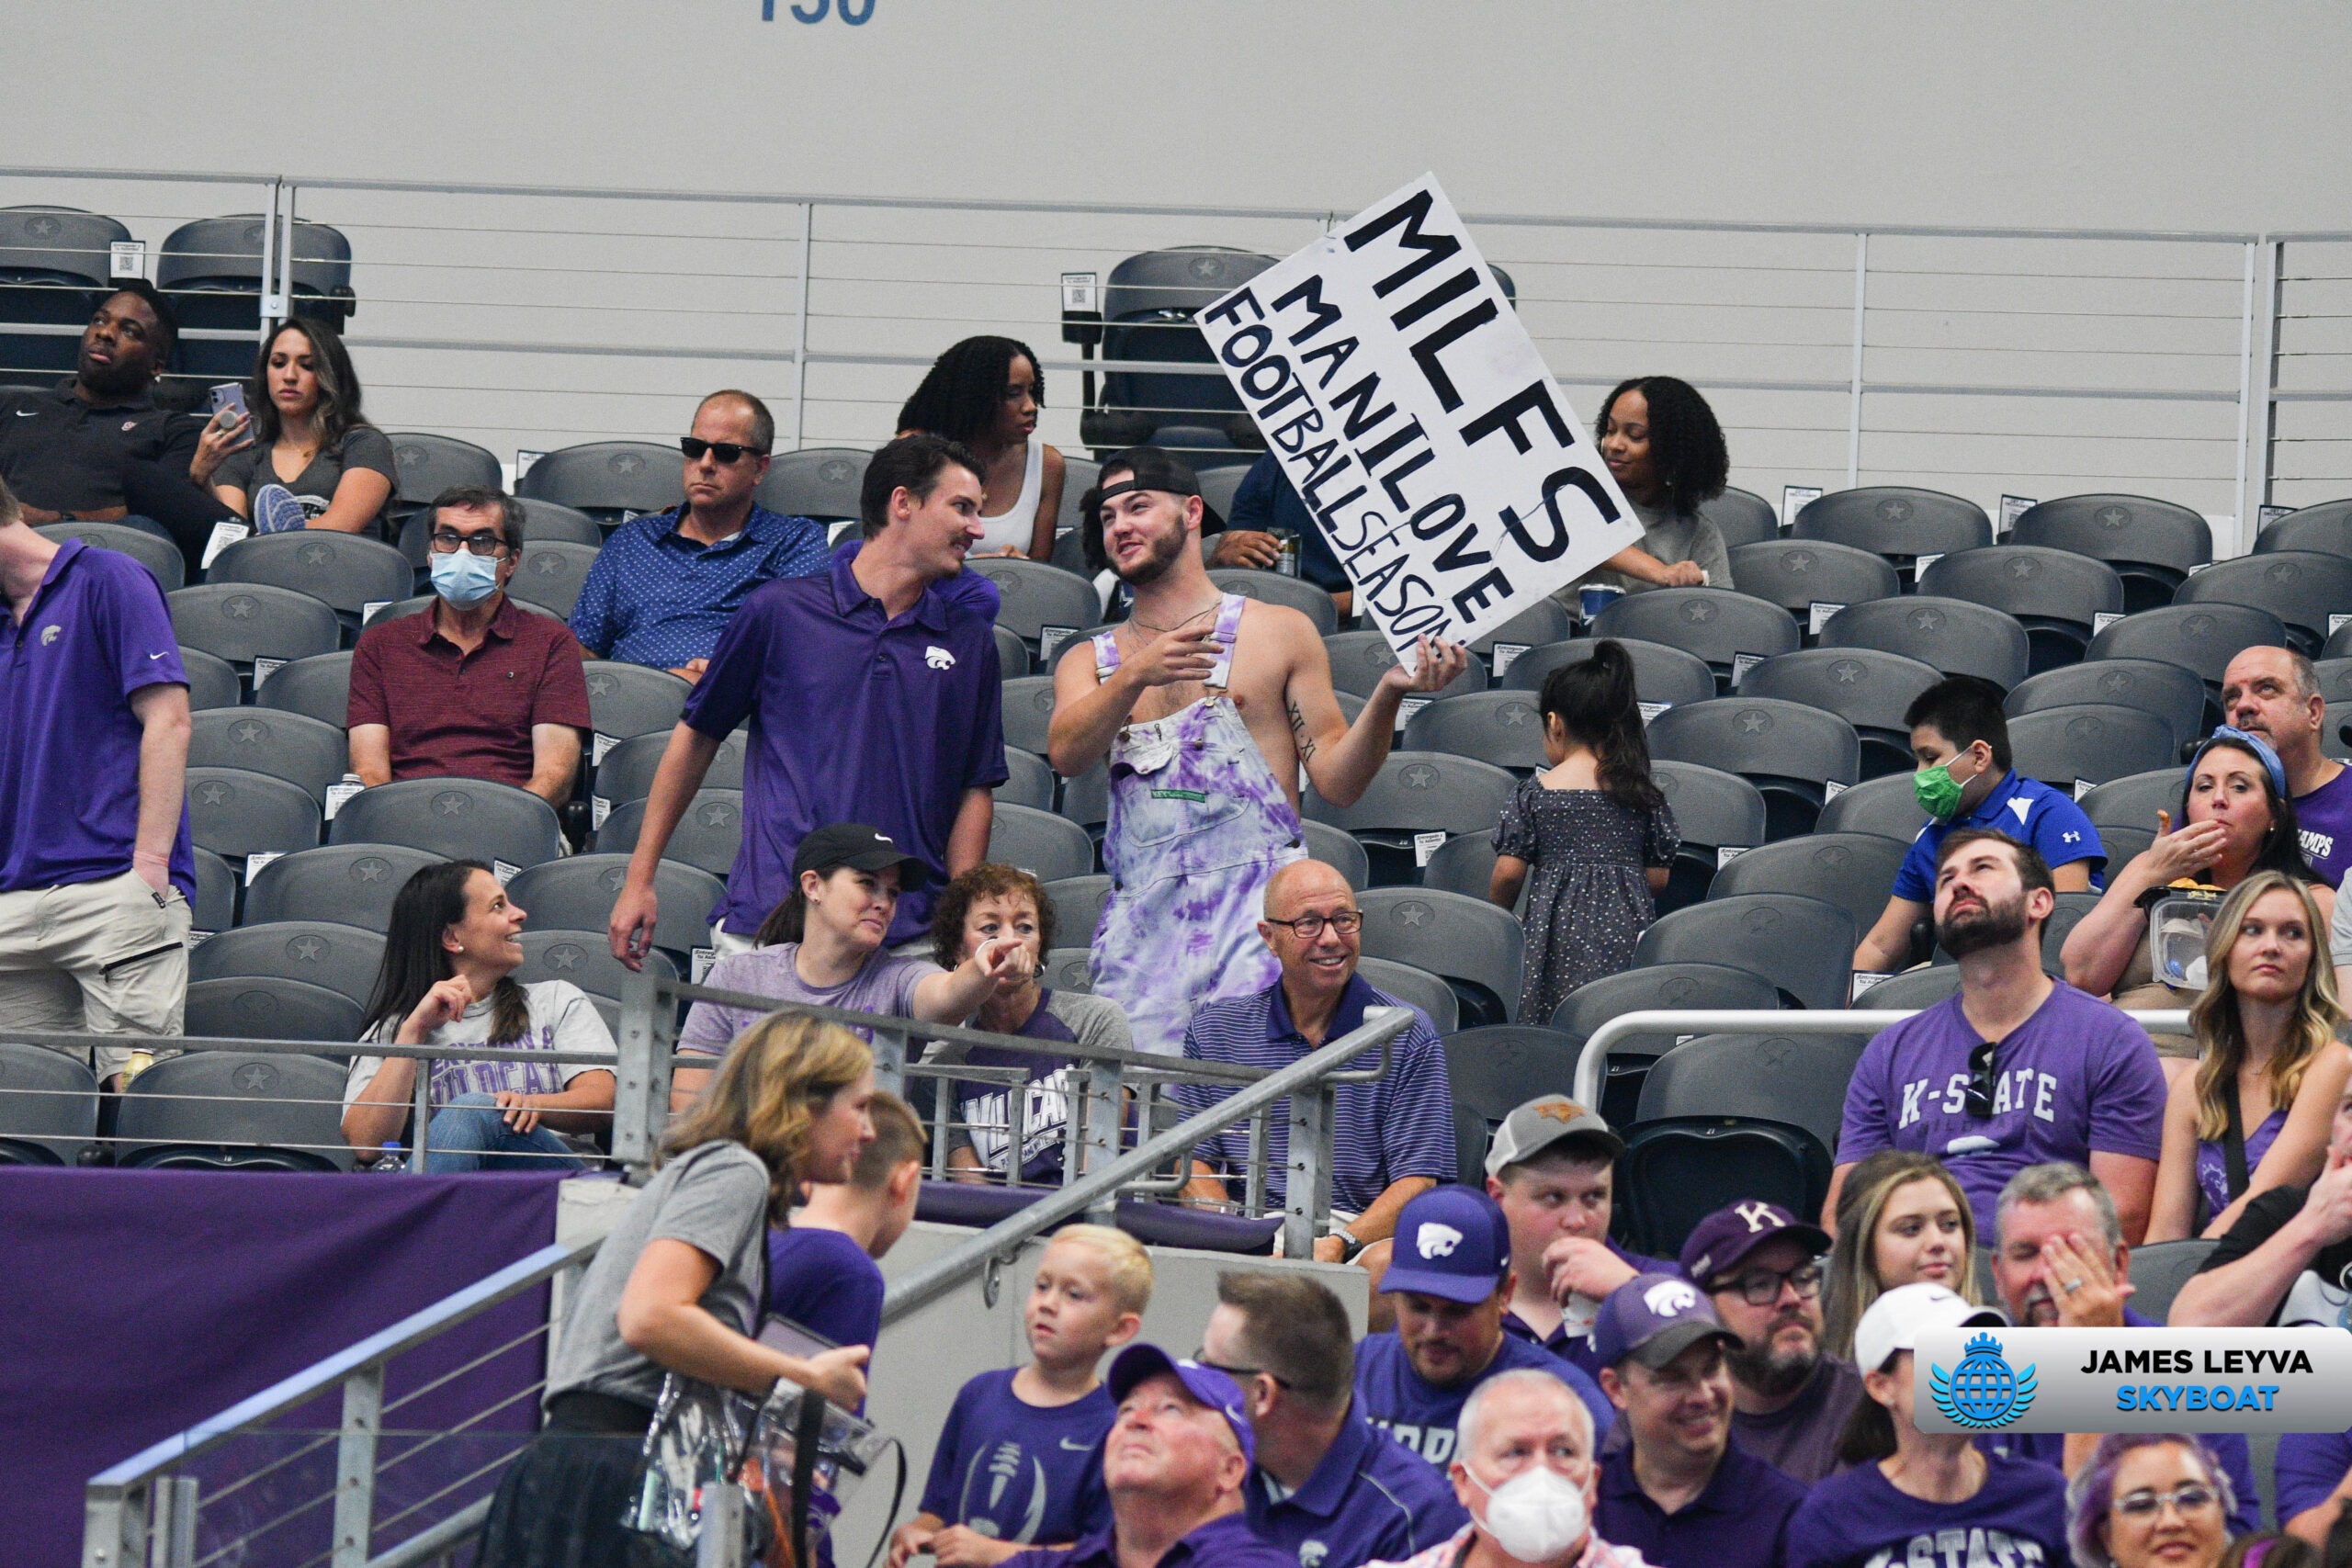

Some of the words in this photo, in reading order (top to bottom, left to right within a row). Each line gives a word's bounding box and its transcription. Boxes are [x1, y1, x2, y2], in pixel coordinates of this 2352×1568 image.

[1344, 189, 1622, 563] MILFS
[2297, 829, 2335, 857] AMPS
[1898, 1067, 2058, 1130] K-SATE
[1734, 1201, 1786, 1234] K
